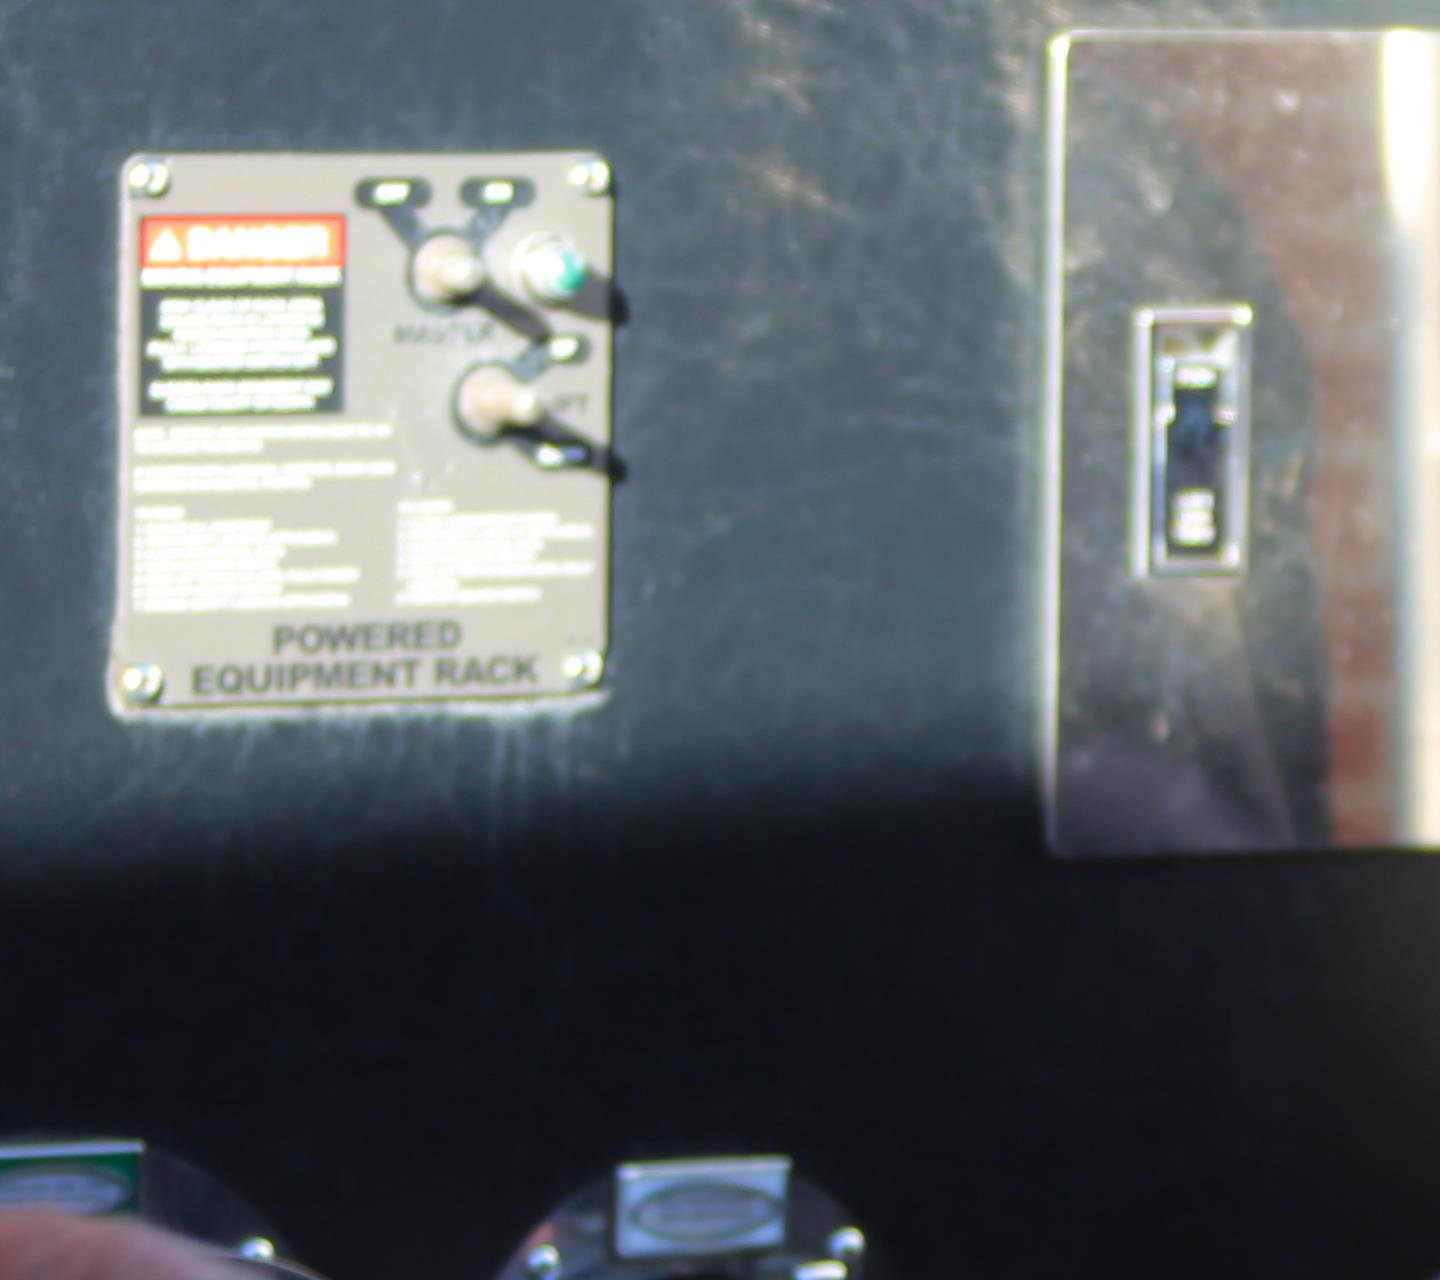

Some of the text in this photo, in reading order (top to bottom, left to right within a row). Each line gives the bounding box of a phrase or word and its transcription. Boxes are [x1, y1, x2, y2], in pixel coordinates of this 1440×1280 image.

[186, 224, 330, 260] DANGER
[273, 622, 463, 655] POWERED
[191, 655, 540, 696] EQUIPMENT RACK
